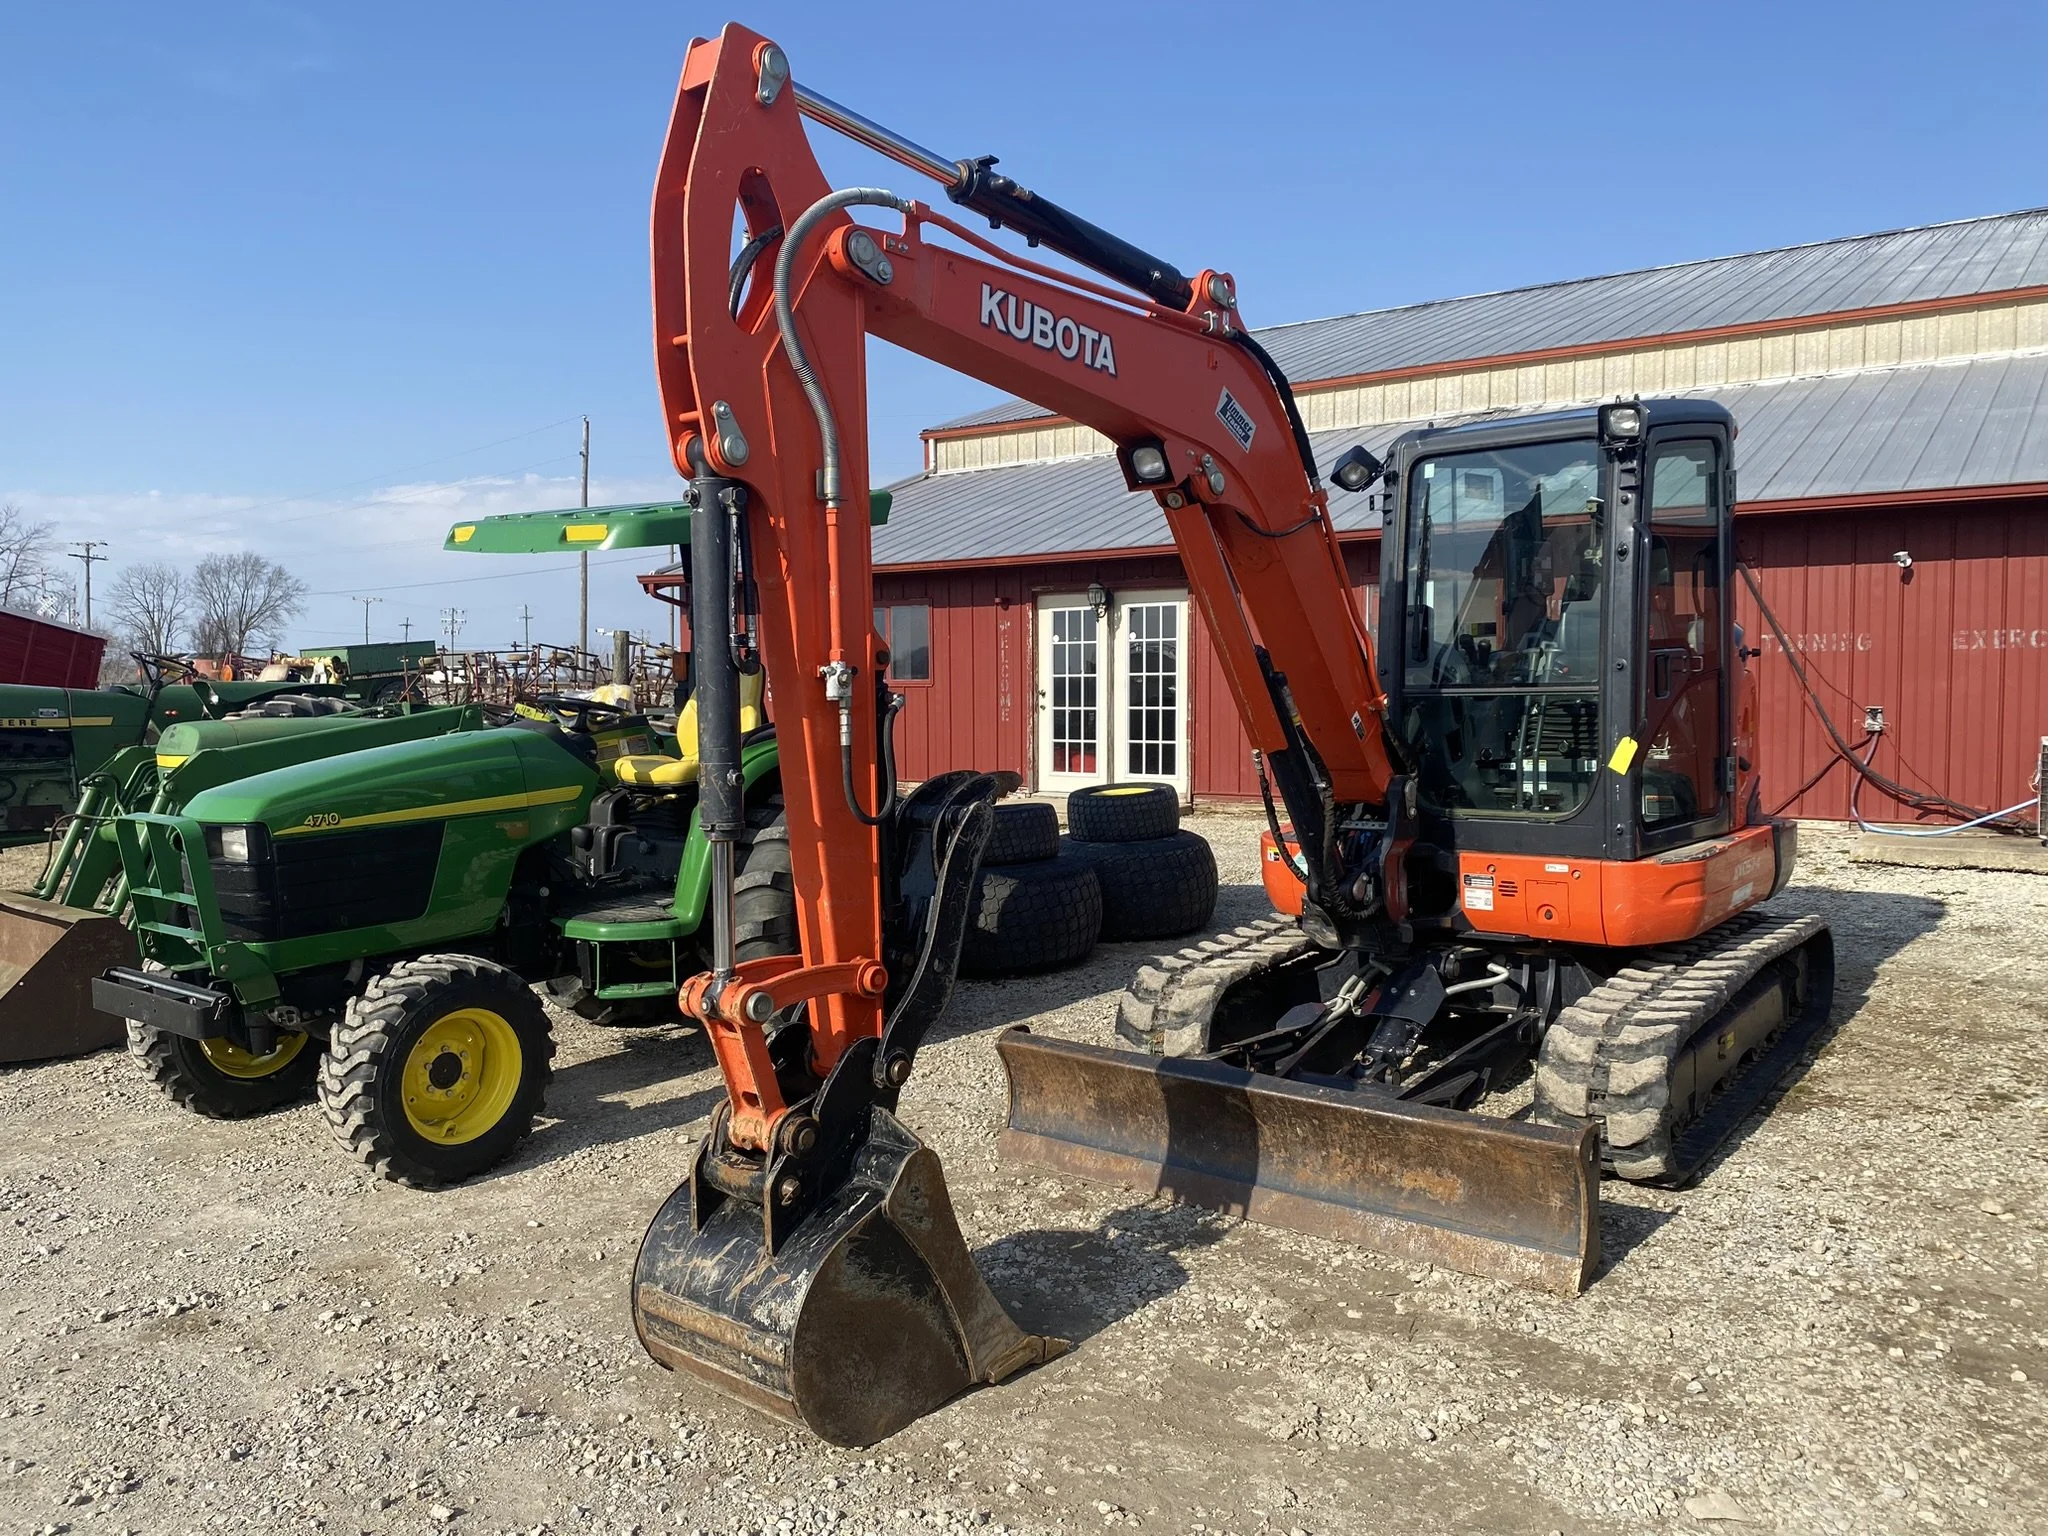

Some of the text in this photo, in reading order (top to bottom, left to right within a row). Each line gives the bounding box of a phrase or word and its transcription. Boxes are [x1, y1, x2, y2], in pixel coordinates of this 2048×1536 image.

[980, 282, 1117, 376] KUBOTA
[1219, 392, 1253, 433] Zimmer
[1225, 411, 1246, 438] Tractor
[303, 812, 340, 827] 4710
